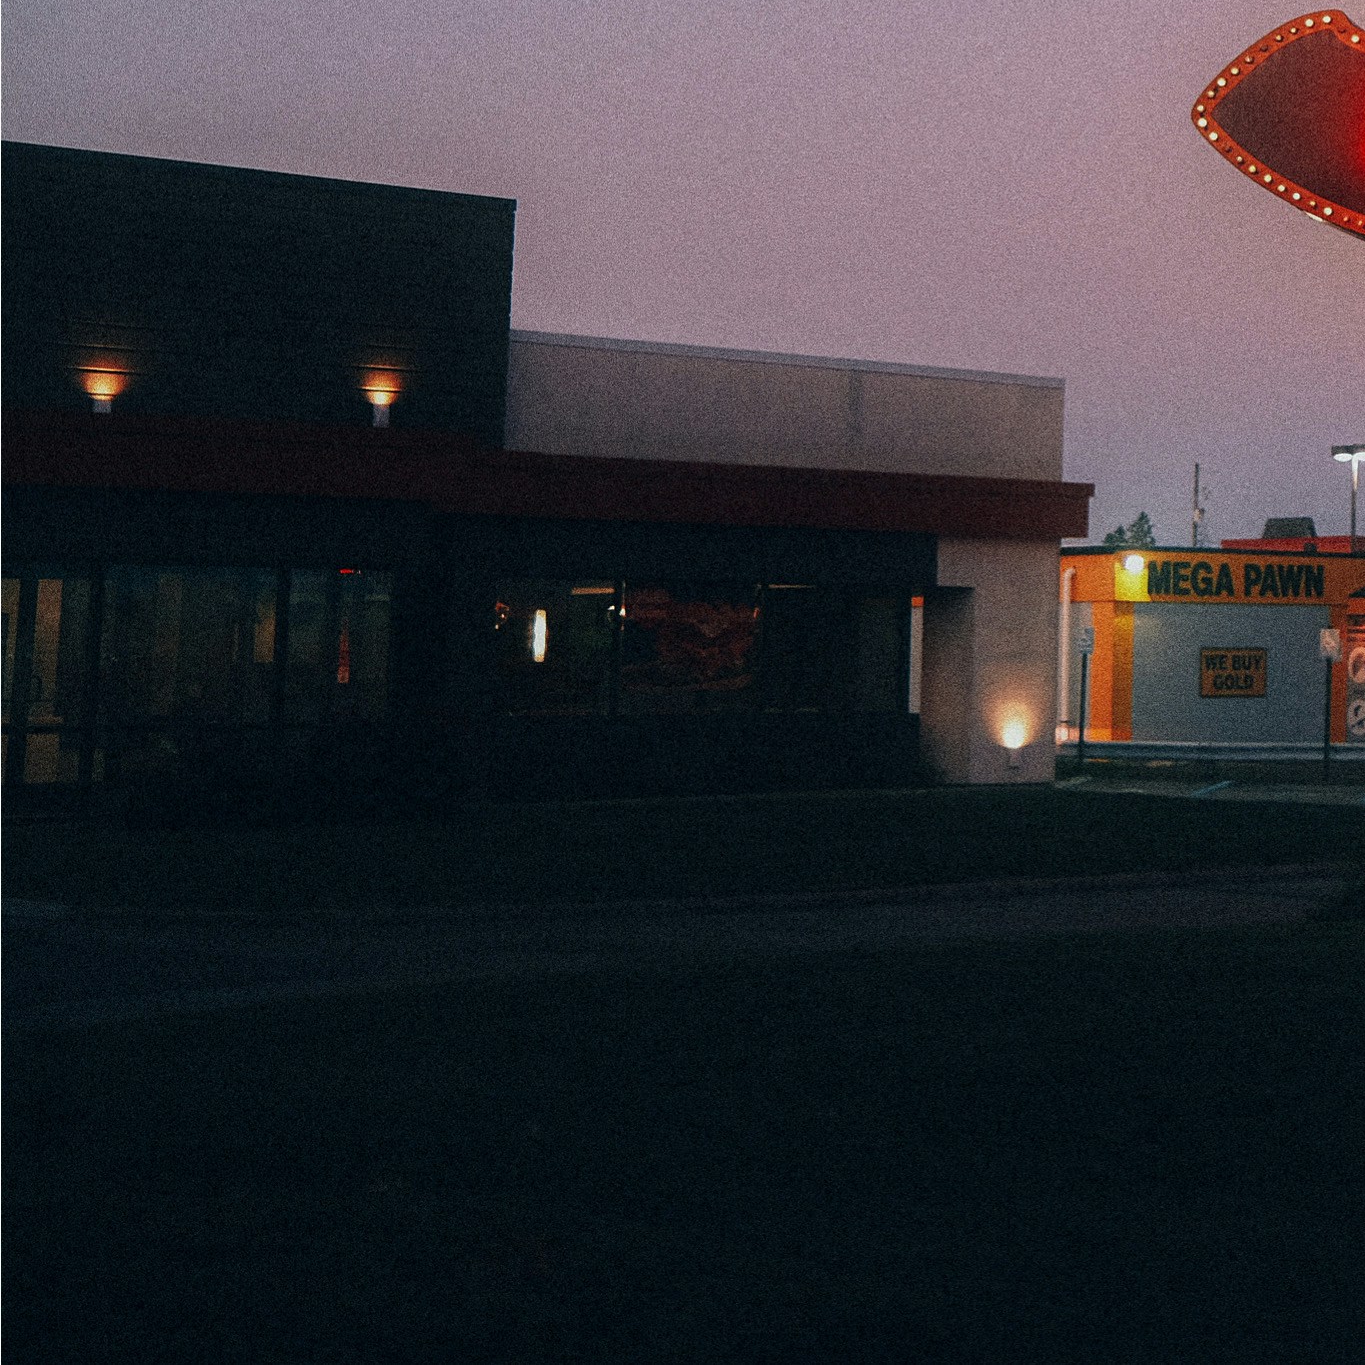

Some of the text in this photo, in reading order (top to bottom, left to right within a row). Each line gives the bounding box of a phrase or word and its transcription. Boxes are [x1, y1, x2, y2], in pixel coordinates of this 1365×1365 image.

[1146, 561, 1326, 599] MEGA PAWN
[1205, 654, 1264, 671] WE BUY
[1213, 673, 1254, 691] GOLD
